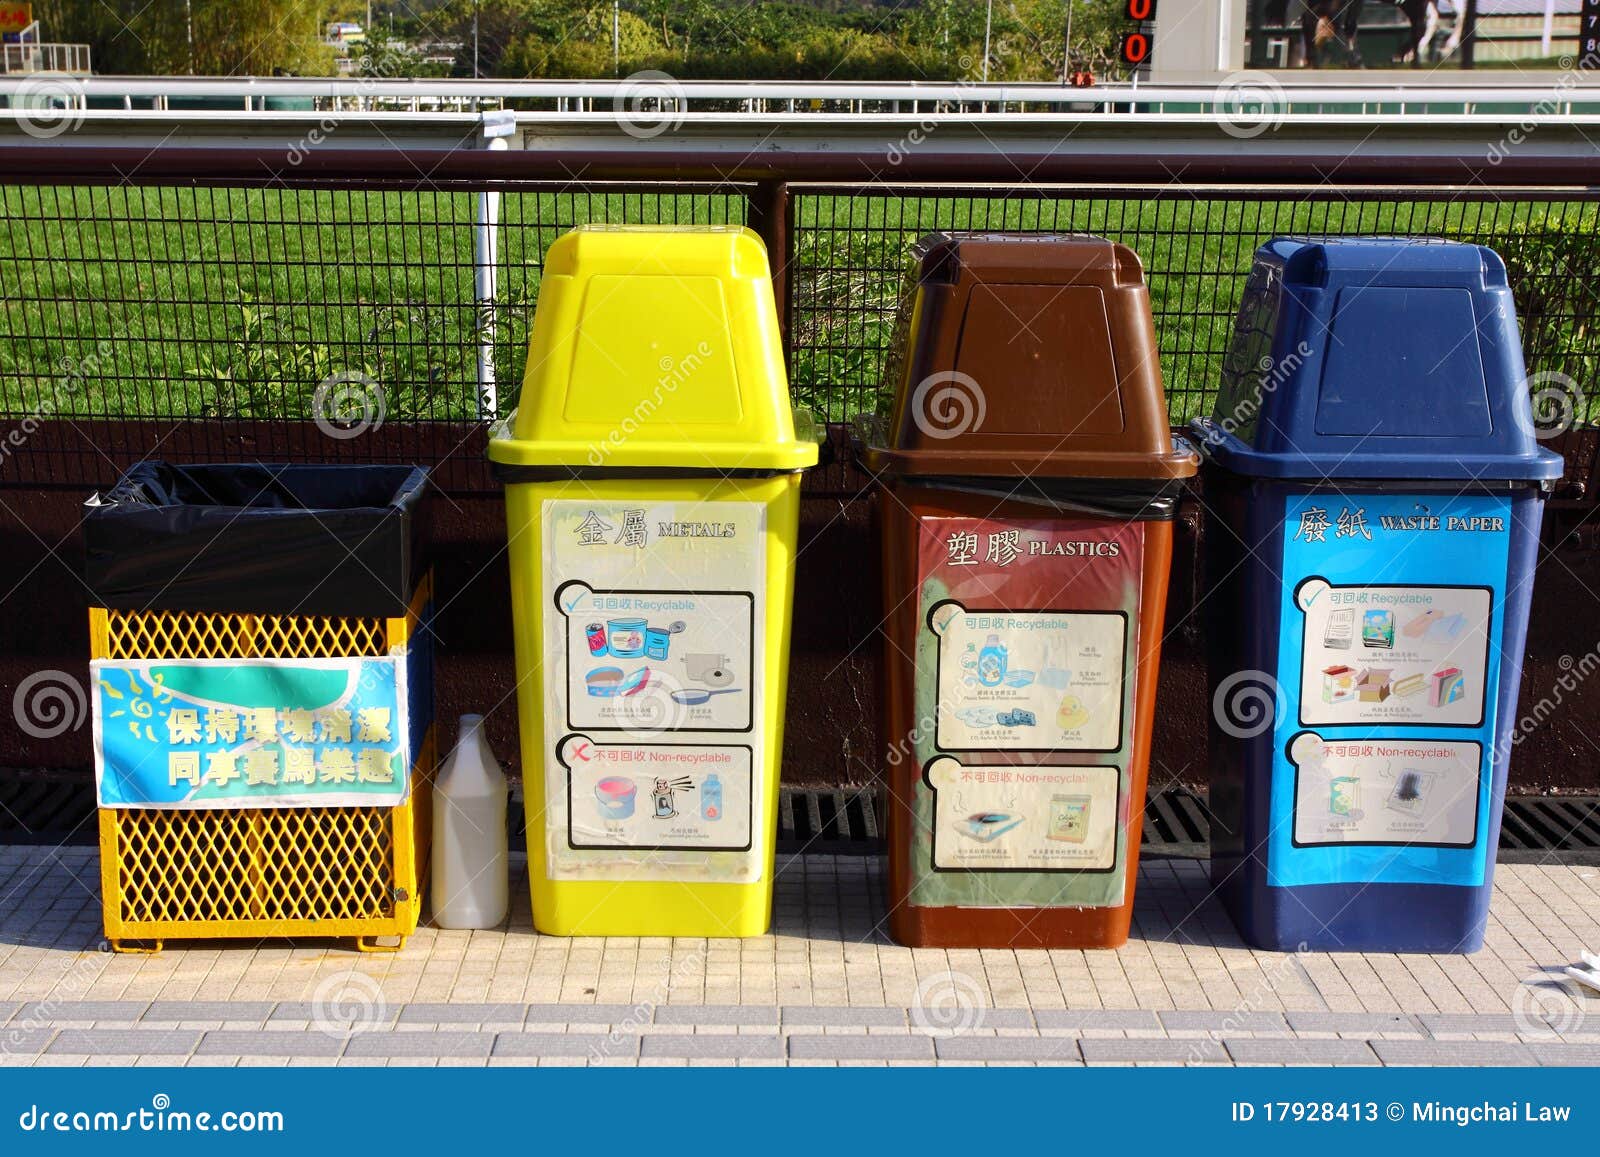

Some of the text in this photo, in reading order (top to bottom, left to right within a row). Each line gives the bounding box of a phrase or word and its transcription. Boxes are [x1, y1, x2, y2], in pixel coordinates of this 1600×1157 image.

[1588, 15, 1597, 28] 7
[1125, 33, 1147, 63] 0
[1586, 38, 1596, 51] 8
[573, 509, 736, 549] 金屬 METALS
[1292, 507, 1505, 543] 廢紙 WASTE PAPER
[946, 529, 1120, 567] 塑膠 PLASTICS
[592, 597, 695, 612] 可回收 Recyclable
[1331, 592, 1433, 606] 可回收 Recyclable
[965, 617, 1068, 632] 可回收 Recyclable
[166, 706, 391, 744] 保持環境清潔
[594, 749, 731, 764] 不可回收 Non-recyclable
[1377, 747, 1456, 759] Non-recyclabl
[1016, 773, 1089, 784] Non-recyclab
